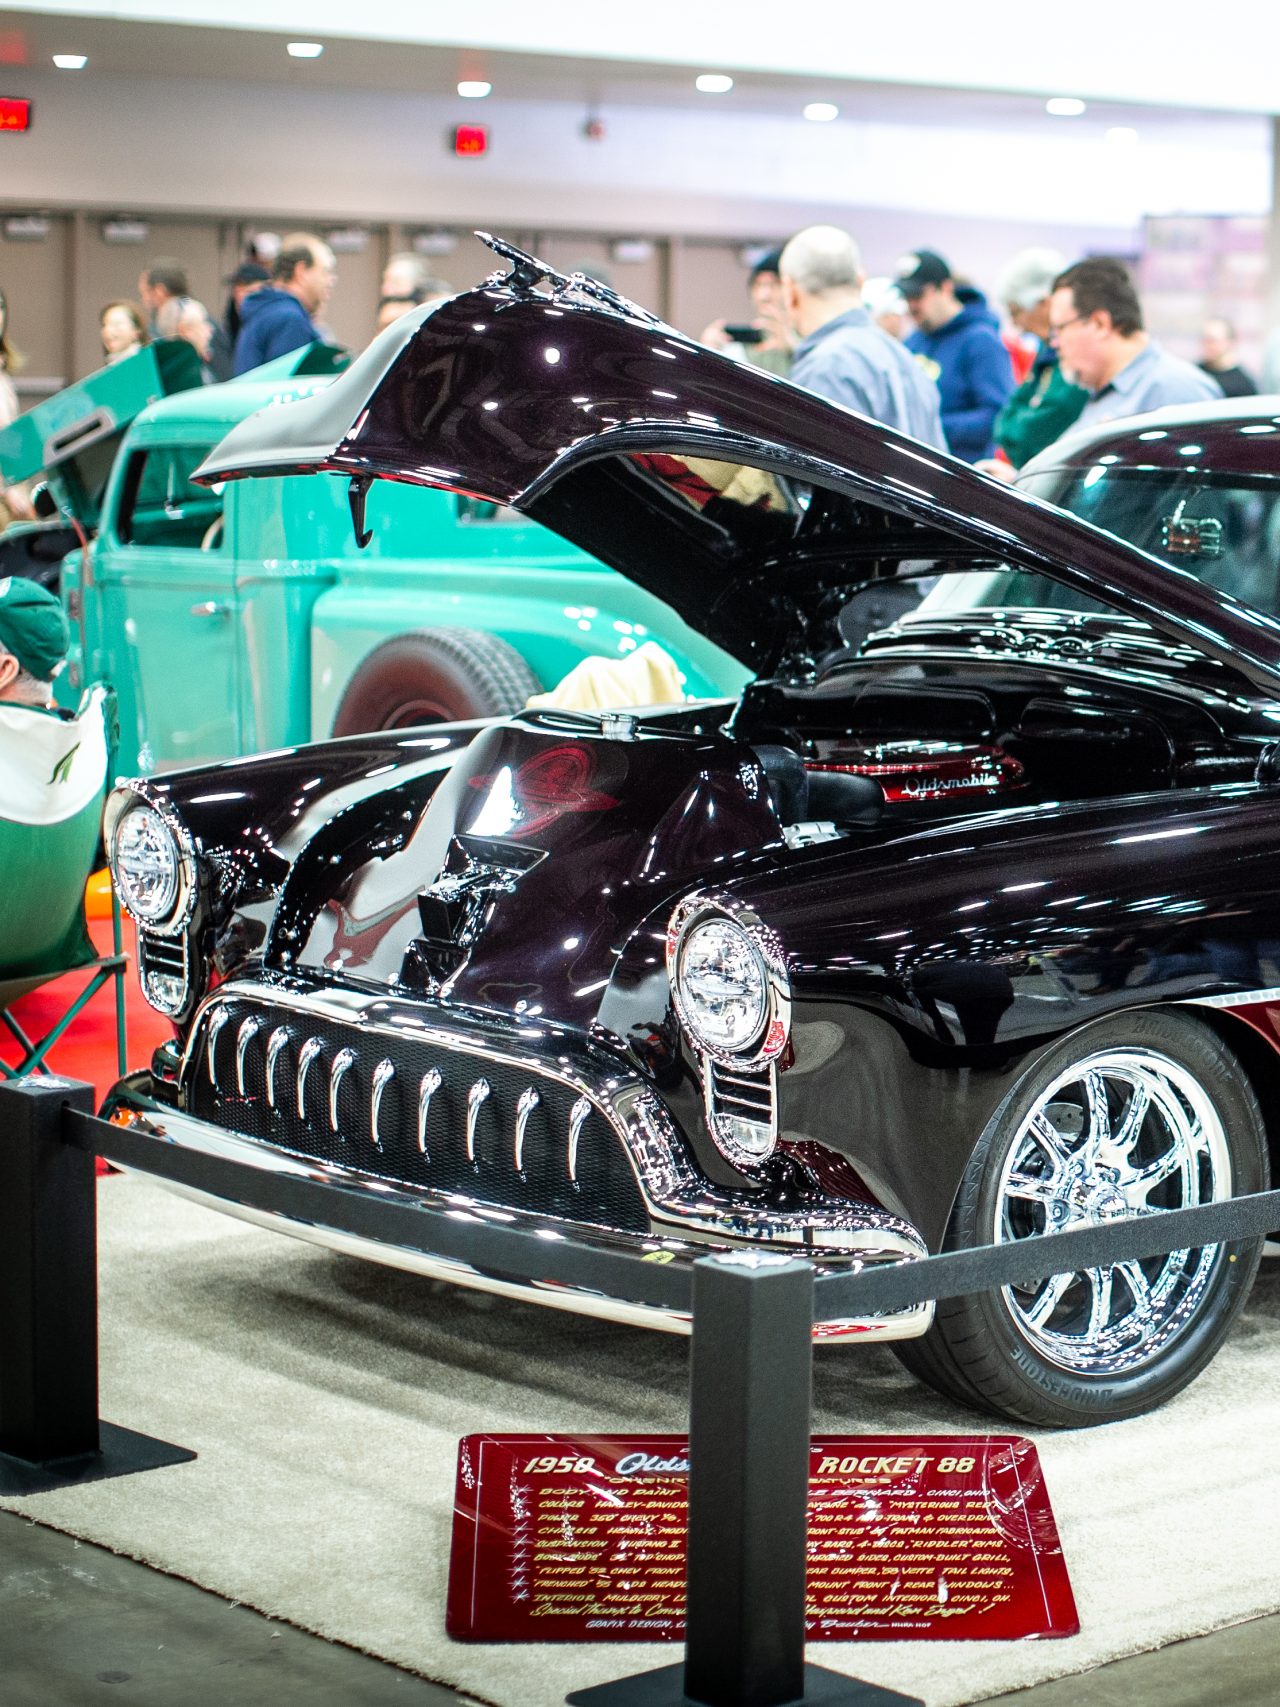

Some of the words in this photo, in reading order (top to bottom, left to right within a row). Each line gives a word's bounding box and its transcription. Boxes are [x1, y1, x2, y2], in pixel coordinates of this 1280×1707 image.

[902, 773, 1000, 794] Oldsmobile
[817, 1456, 935, 1474] ROCKET
[937, 1456, 976, 1474] 88
[807, 1477, 892, 1487] EATURES
[539, 1500, 586, 1509] COLORS
[595, 1501, 690, 1509] HALEY-DAVIDS
[534, 1540, 609, 1549] SUSPENSION
[533, 1593, 596, 1602] INTERIOR
